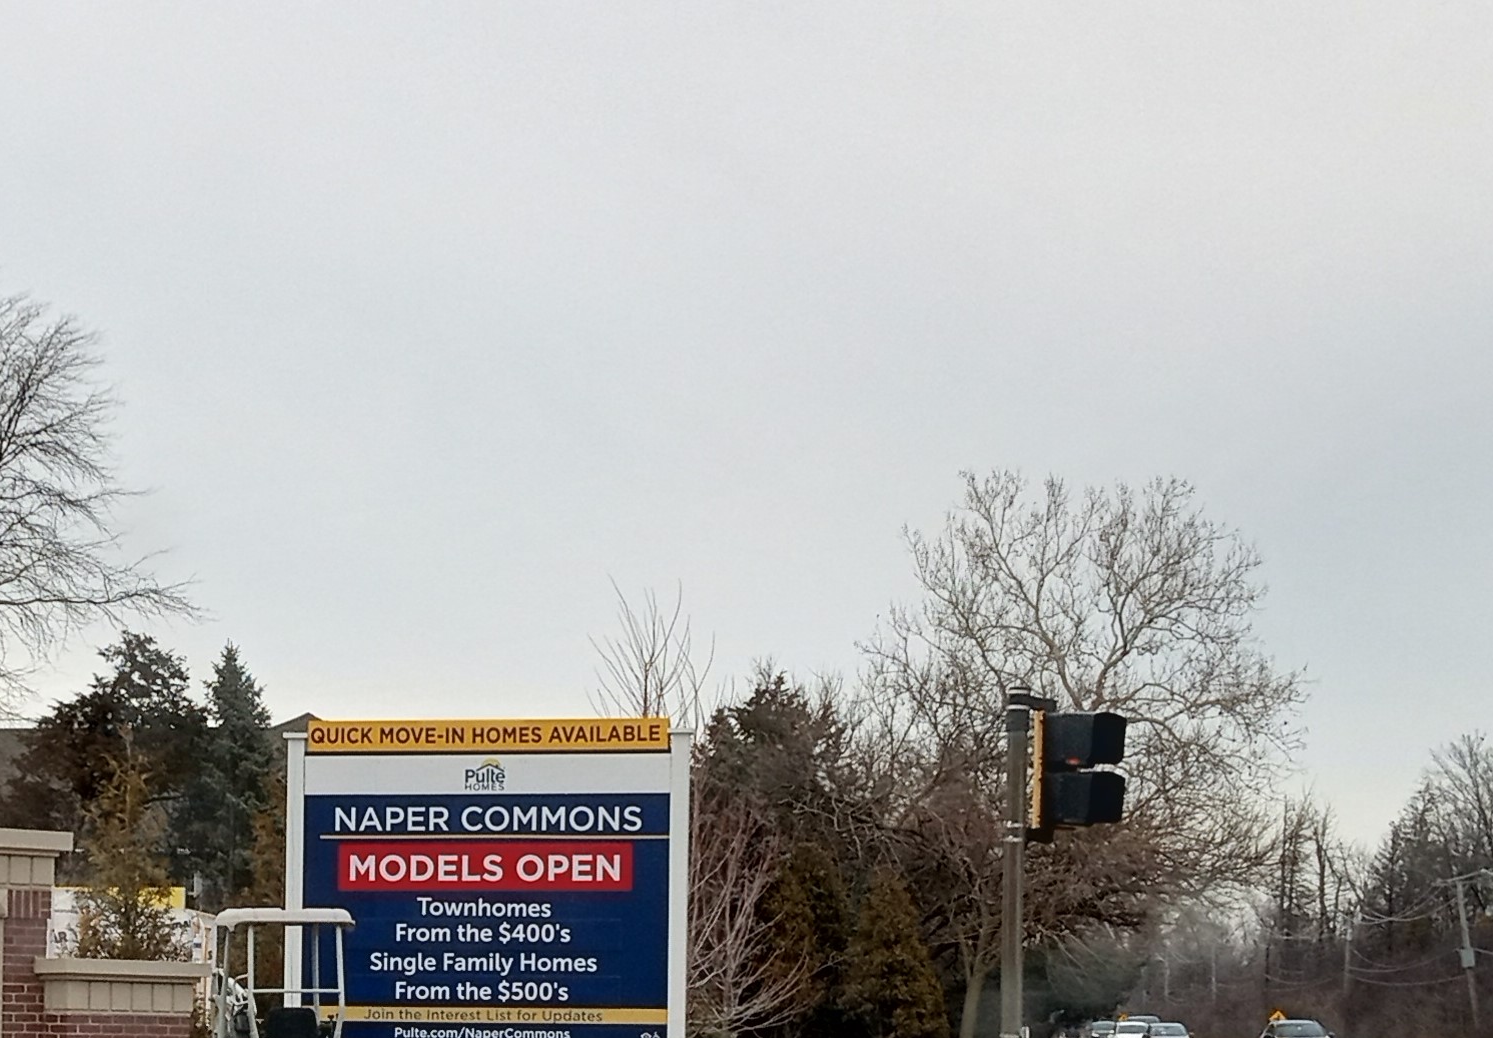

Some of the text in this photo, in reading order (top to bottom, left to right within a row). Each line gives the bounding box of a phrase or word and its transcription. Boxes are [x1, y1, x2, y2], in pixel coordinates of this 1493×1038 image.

[311, 724, 661, 744] QUICK MOVE-IN HOMES AVAILABLE
[465, 767, 506, 784] Pulte
[464, 783, 505, 791] HOMES
[334, 805, 643, 832] NAPER COMMONS
[348, 853, 621, 883] MODELS OPEN
[416, 897, 552, 918] Townhomes
[395, 921, 571, 945] From the $400's
[369, 952, 598, 977] Single Family Homes
[395, 979, 569, 1003] From the $500's
[364, 1007, 604, 1024] Join the Interest List for Updates
